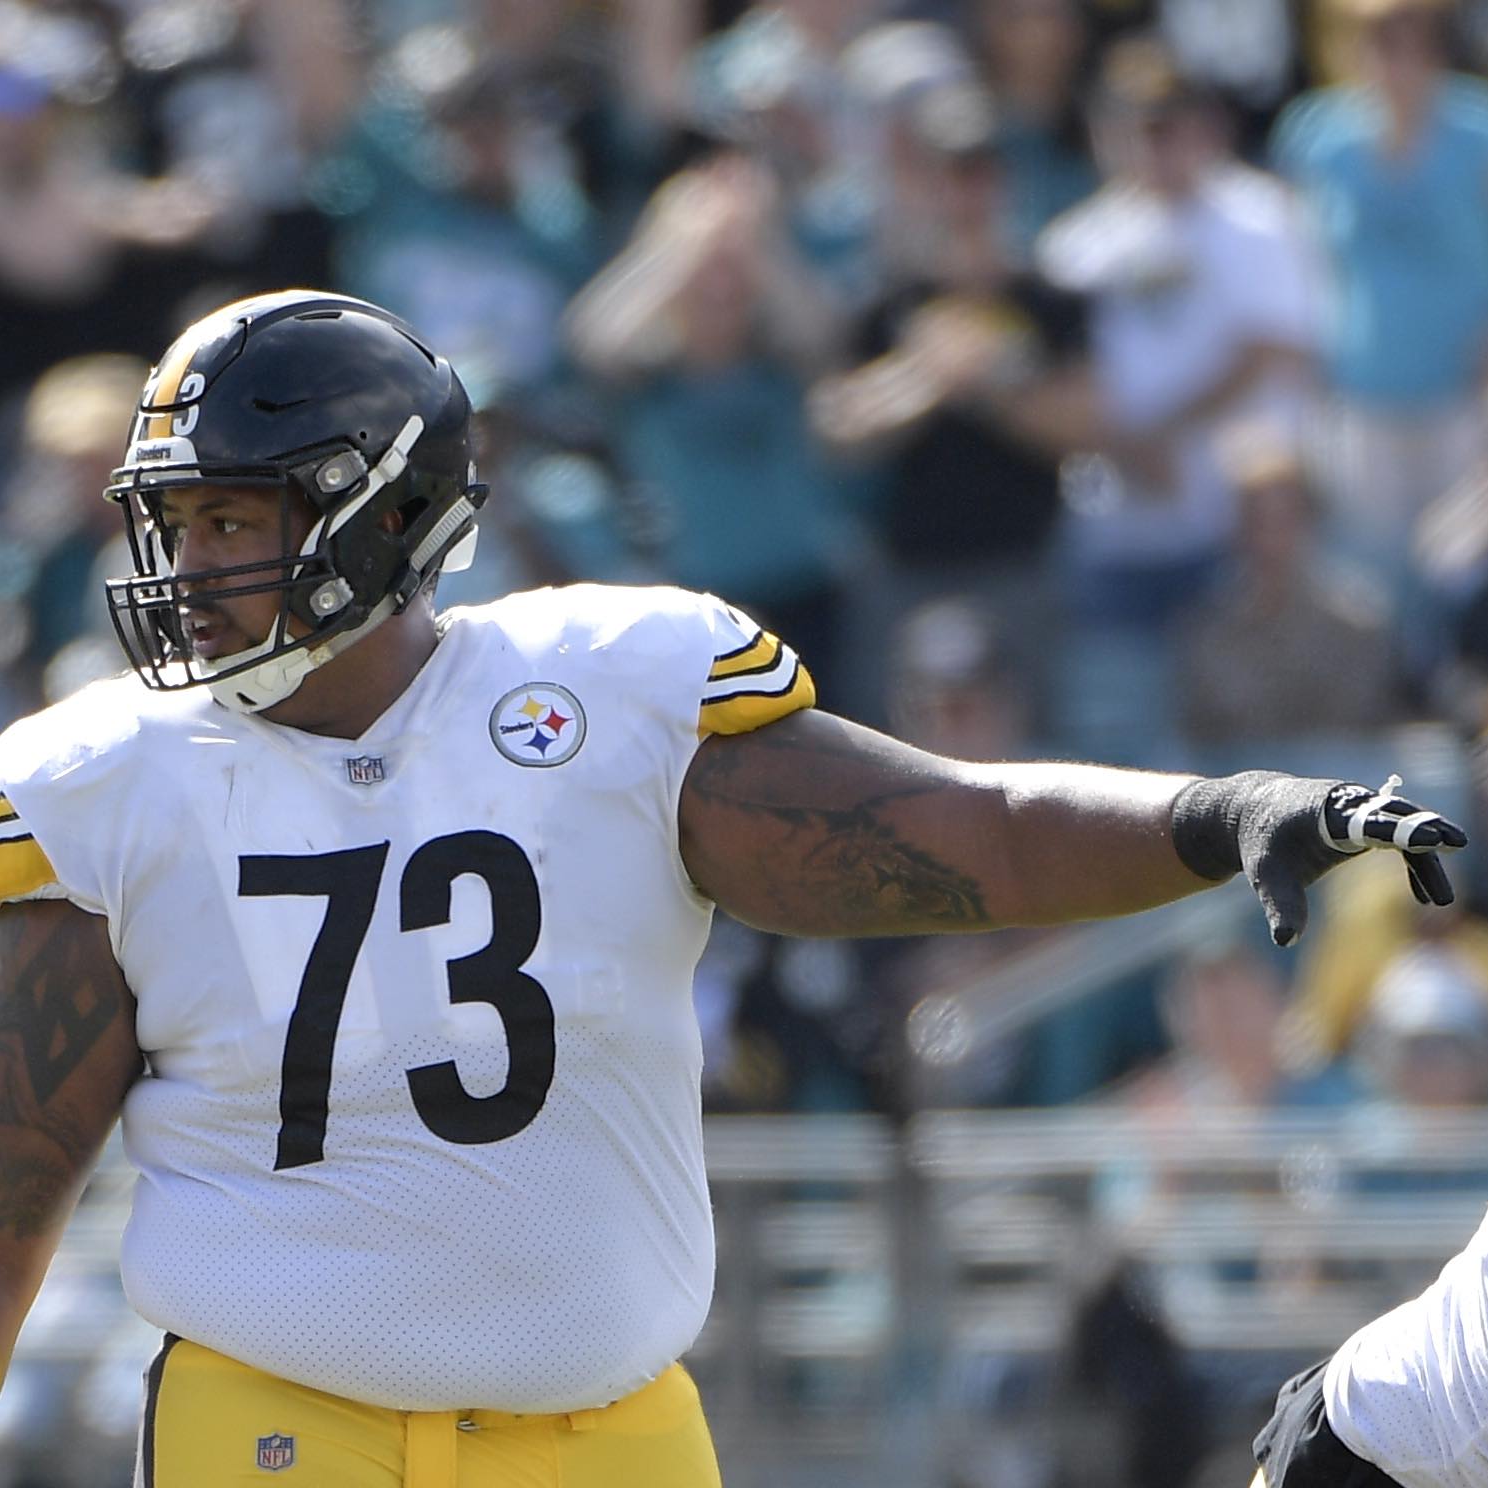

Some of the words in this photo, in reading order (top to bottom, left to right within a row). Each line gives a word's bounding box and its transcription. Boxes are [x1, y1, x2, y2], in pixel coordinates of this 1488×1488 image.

[132, 367, 206, 440] 73
[499, 720, 534, 735] Steelers
[238, 829, 556, 1171] 73
